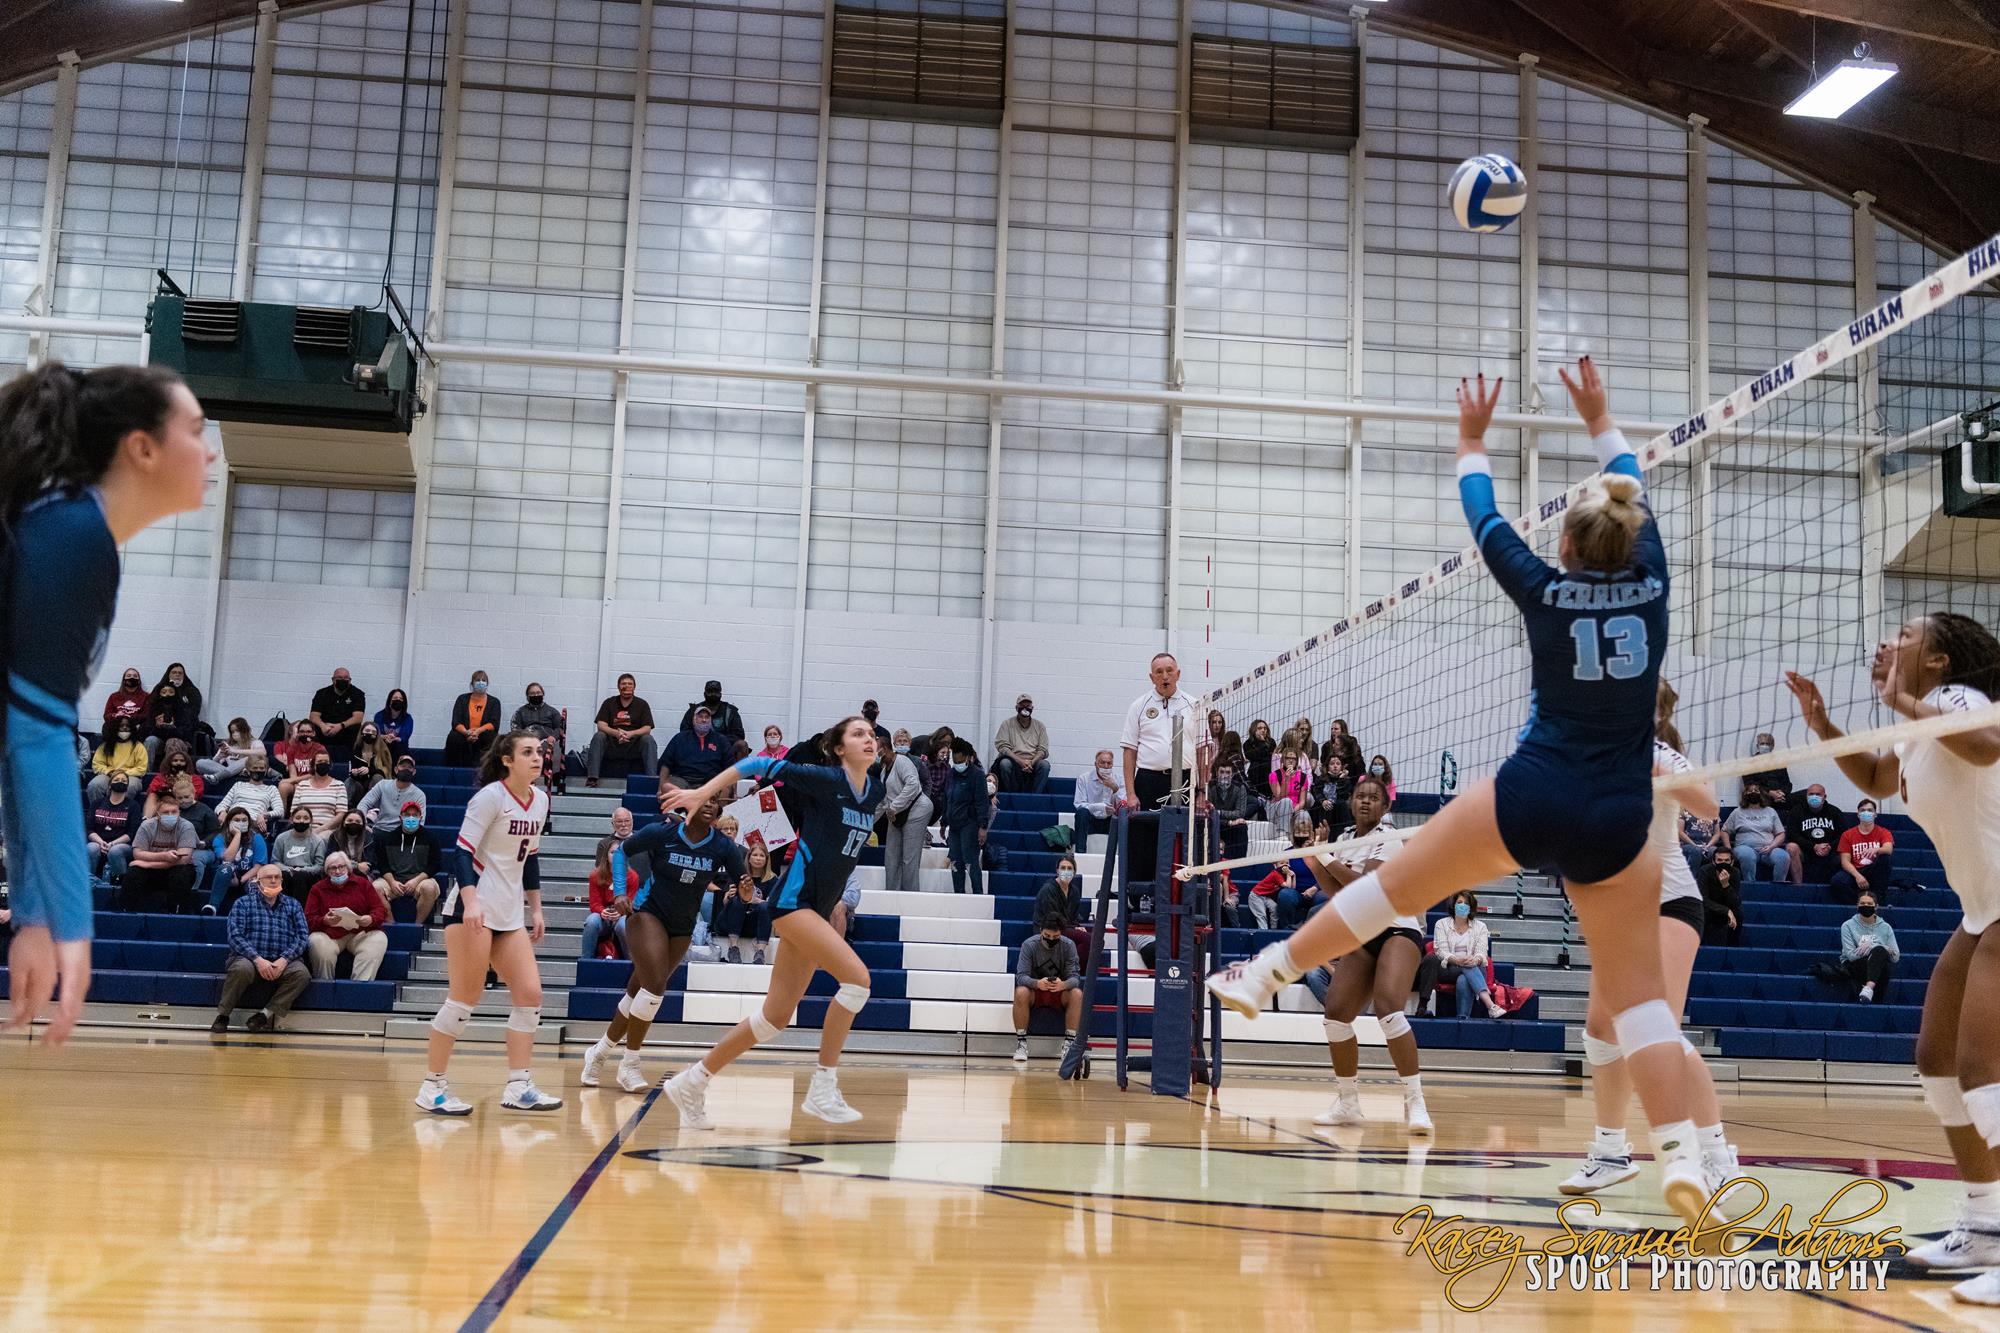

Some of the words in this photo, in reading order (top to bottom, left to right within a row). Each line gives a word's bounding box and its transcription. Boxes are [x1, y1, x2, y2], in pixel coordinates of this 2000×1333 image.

[1849, 297, 1904, 346] HIRAM
[1750, 360, 1795, 402] HIRAM
[1570, 614, 1650, 681] 13
[1802, 817, 1835, 831] HIRAM
[517, 838, 530, 862] 6
[842, 829, 869, 858] 17
[668, 852, 713, 872] HIRAM
[680, 869, 697, 884] 5
